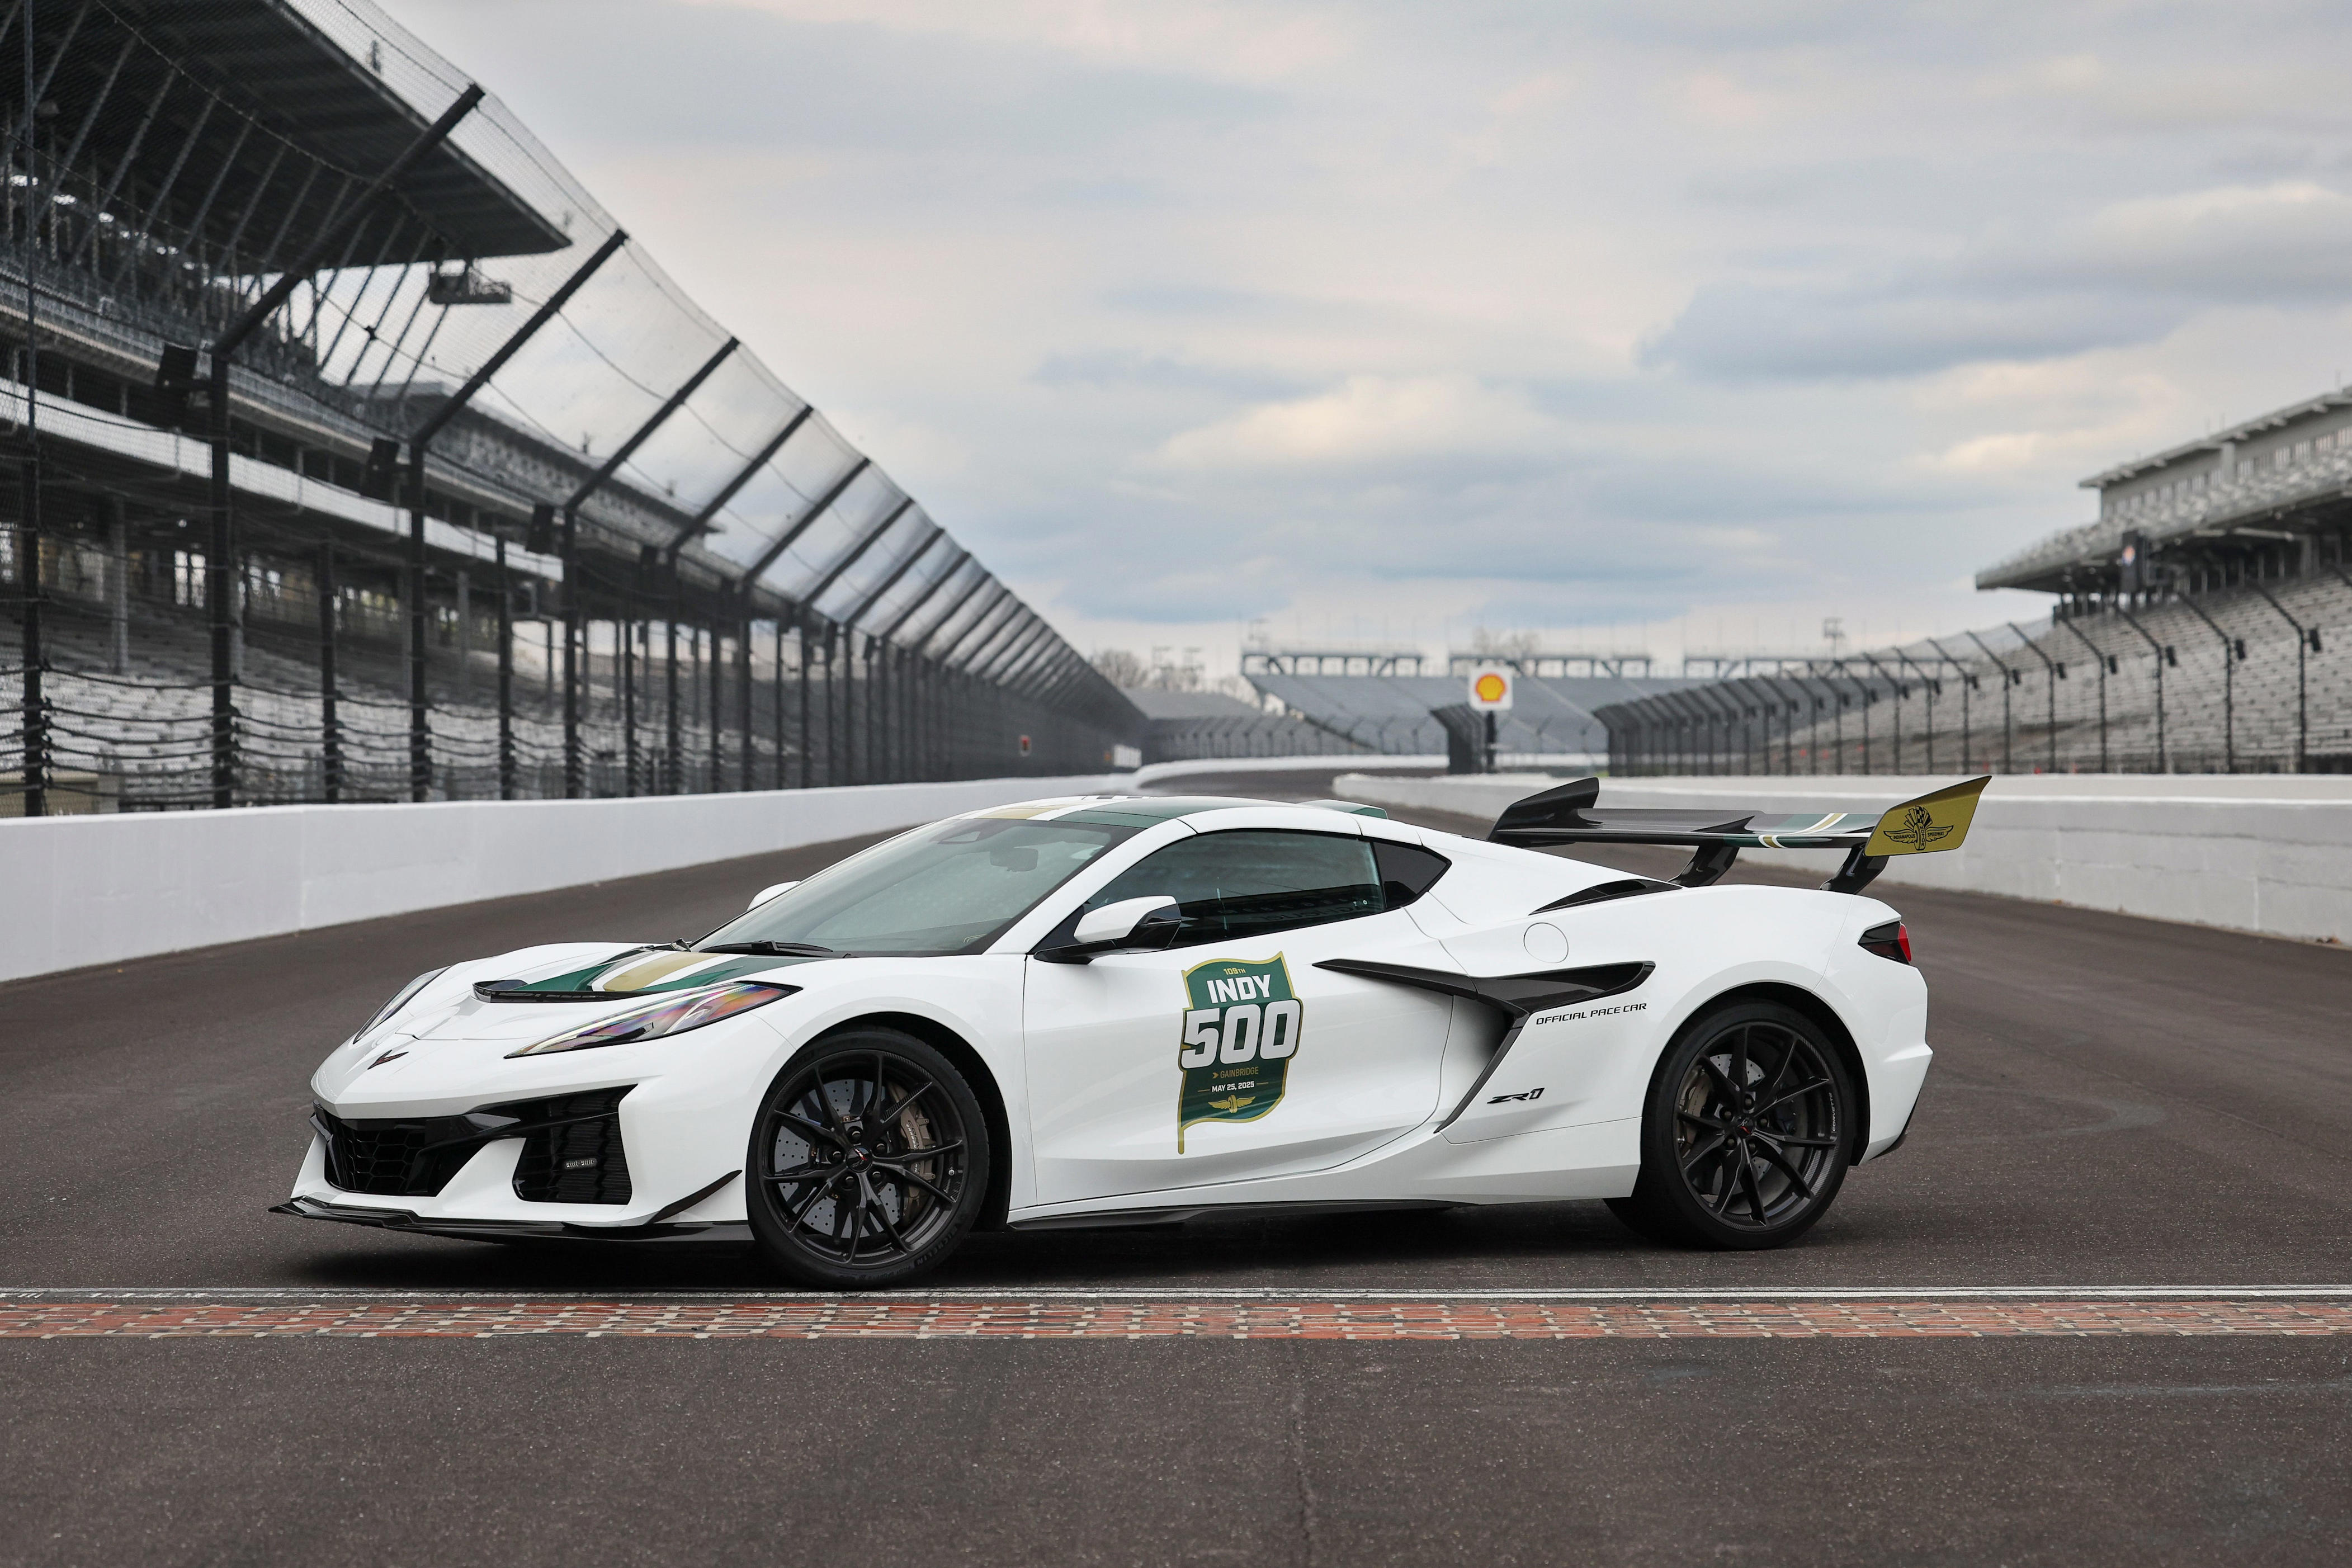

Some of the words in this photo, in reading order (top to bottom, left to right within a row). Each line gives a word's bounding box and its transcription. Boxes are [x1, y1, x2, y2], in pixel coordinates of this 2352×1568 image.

[1223, 967, 1246, 975] 109TH
[1207, 974, 1271, 1004] INDY
[1536, 1012, 1588, 1024] OFFICIAL
[1590, 1007, 1621, 1017] PACE
[1623, 1003, 1647, 1013] CAR
[1181, 999, 1301, 1069] 500
[1220, 1066, 1259, 1079] GAINBRIDGE
[1212, 1084, 1226, 1093] MAY
[1227, 1083, 1237, 1091] 25,
[1238, 1081, 1255, 1089] 2025
[1486, 1088, 1545, 1104] ZR1
[917, 1225, 958, 1265] MICHELIN
